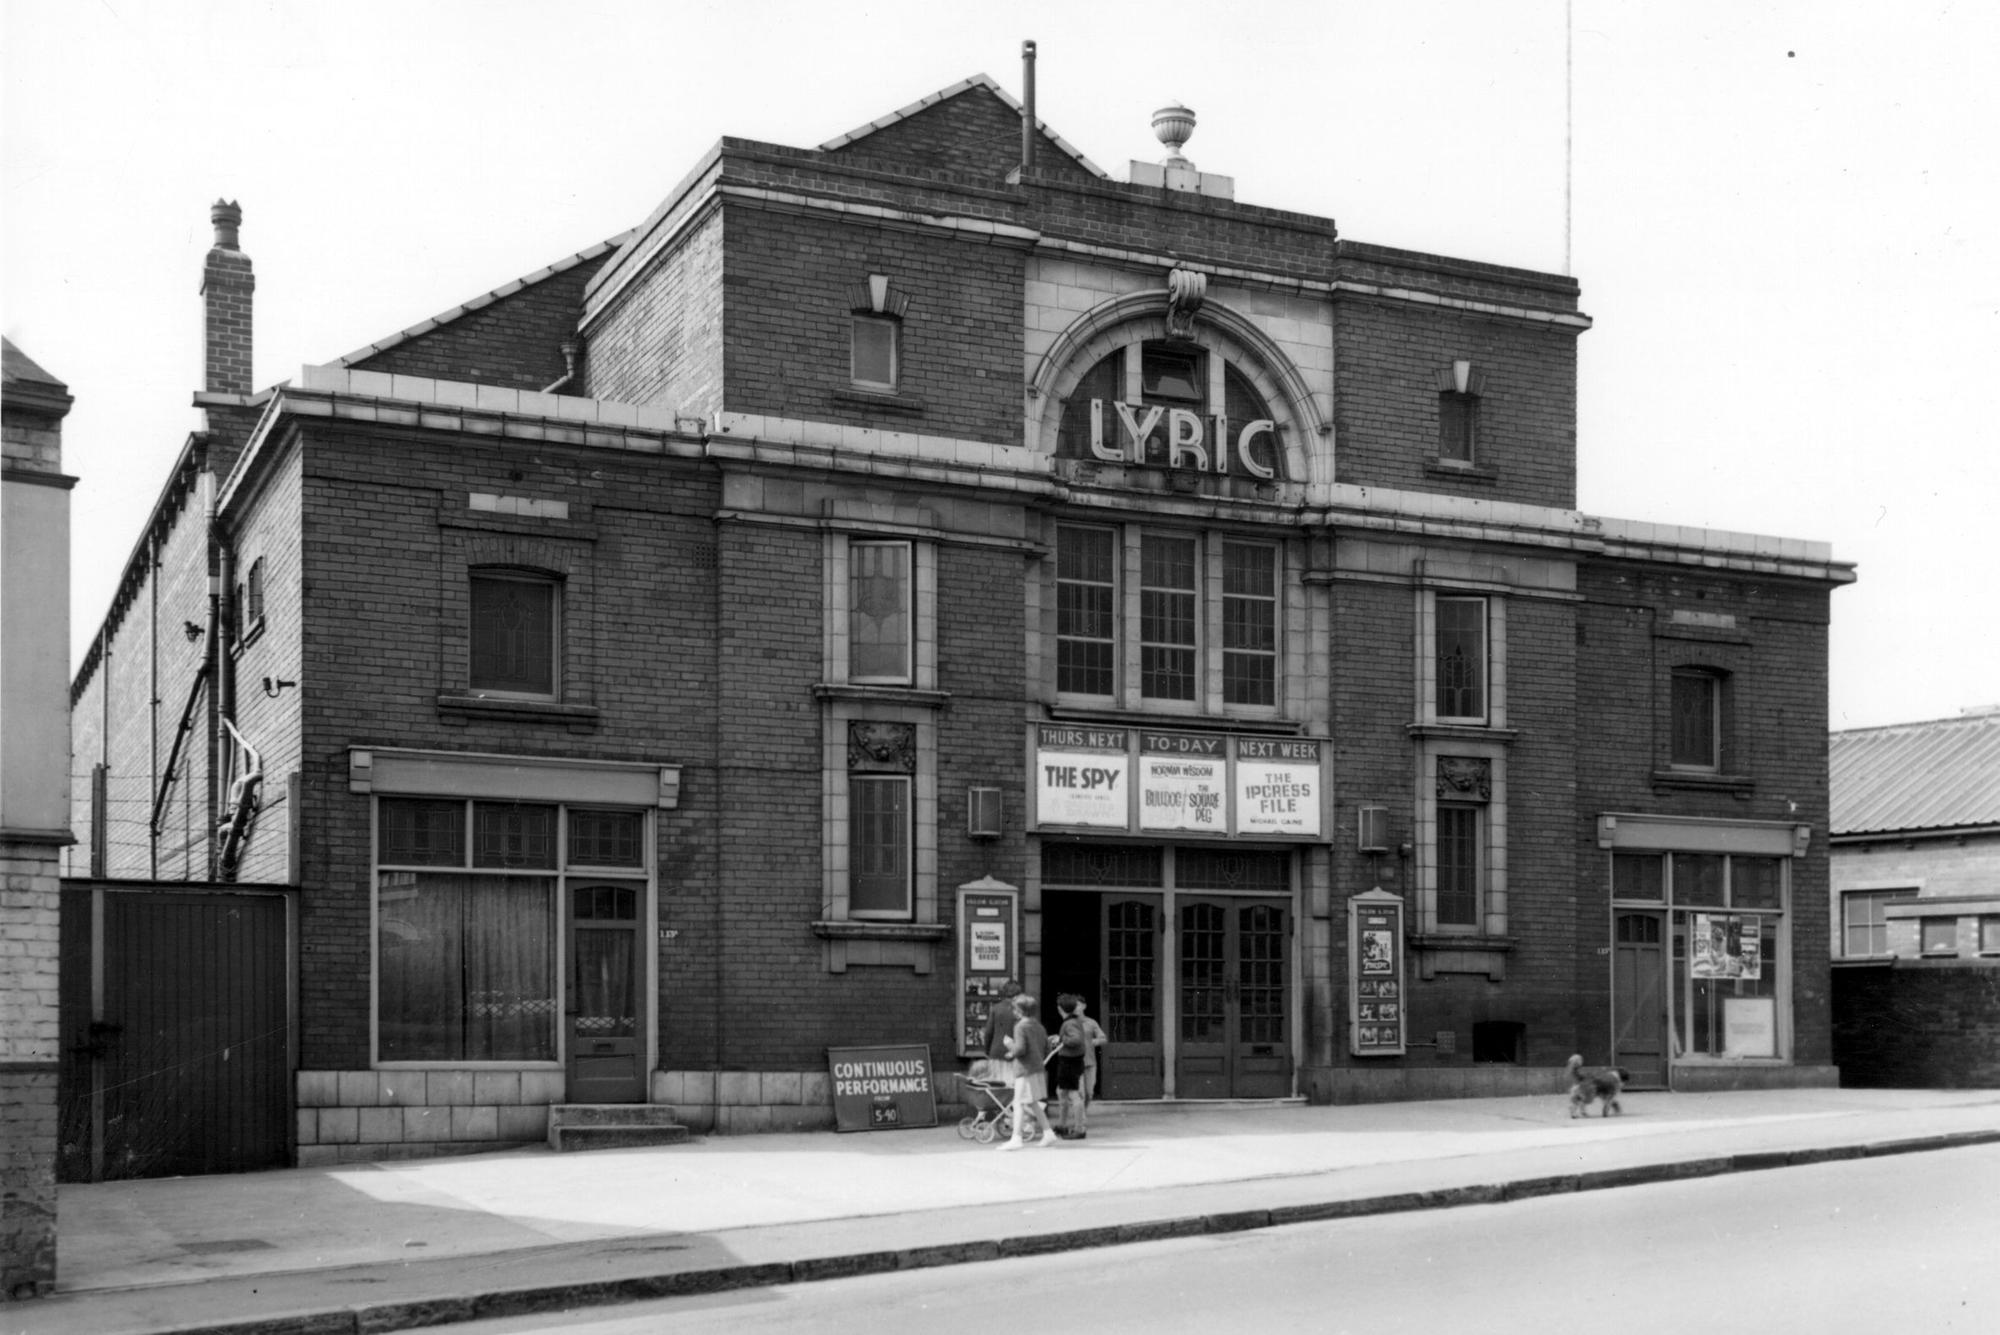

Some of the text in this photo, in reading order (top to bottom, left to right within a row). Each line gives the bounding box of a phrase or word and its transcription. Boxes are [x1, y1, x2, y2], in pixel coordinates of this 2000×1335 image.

[1090, 398, 1275, 479] LYRIC
[1089, 731, 1125, 748] NEXT
[1147, 736, 1218, 753] TO-DAY
[1240, 741, 1318, 759] NEXT WEEK
[1044, 765, 1121, 791] THE SPY
[1264, 772, 1292, 784] THE
[1245, 783, 1311, 800] IPCRESS
[1260, 798, 1297, 814] FILE
[1195, 807, 1212, 823] PEG
[834, 1060, 925, 1079] CONTINUOUS
[836, 1077, 929, 1096] PERFORMANCE
